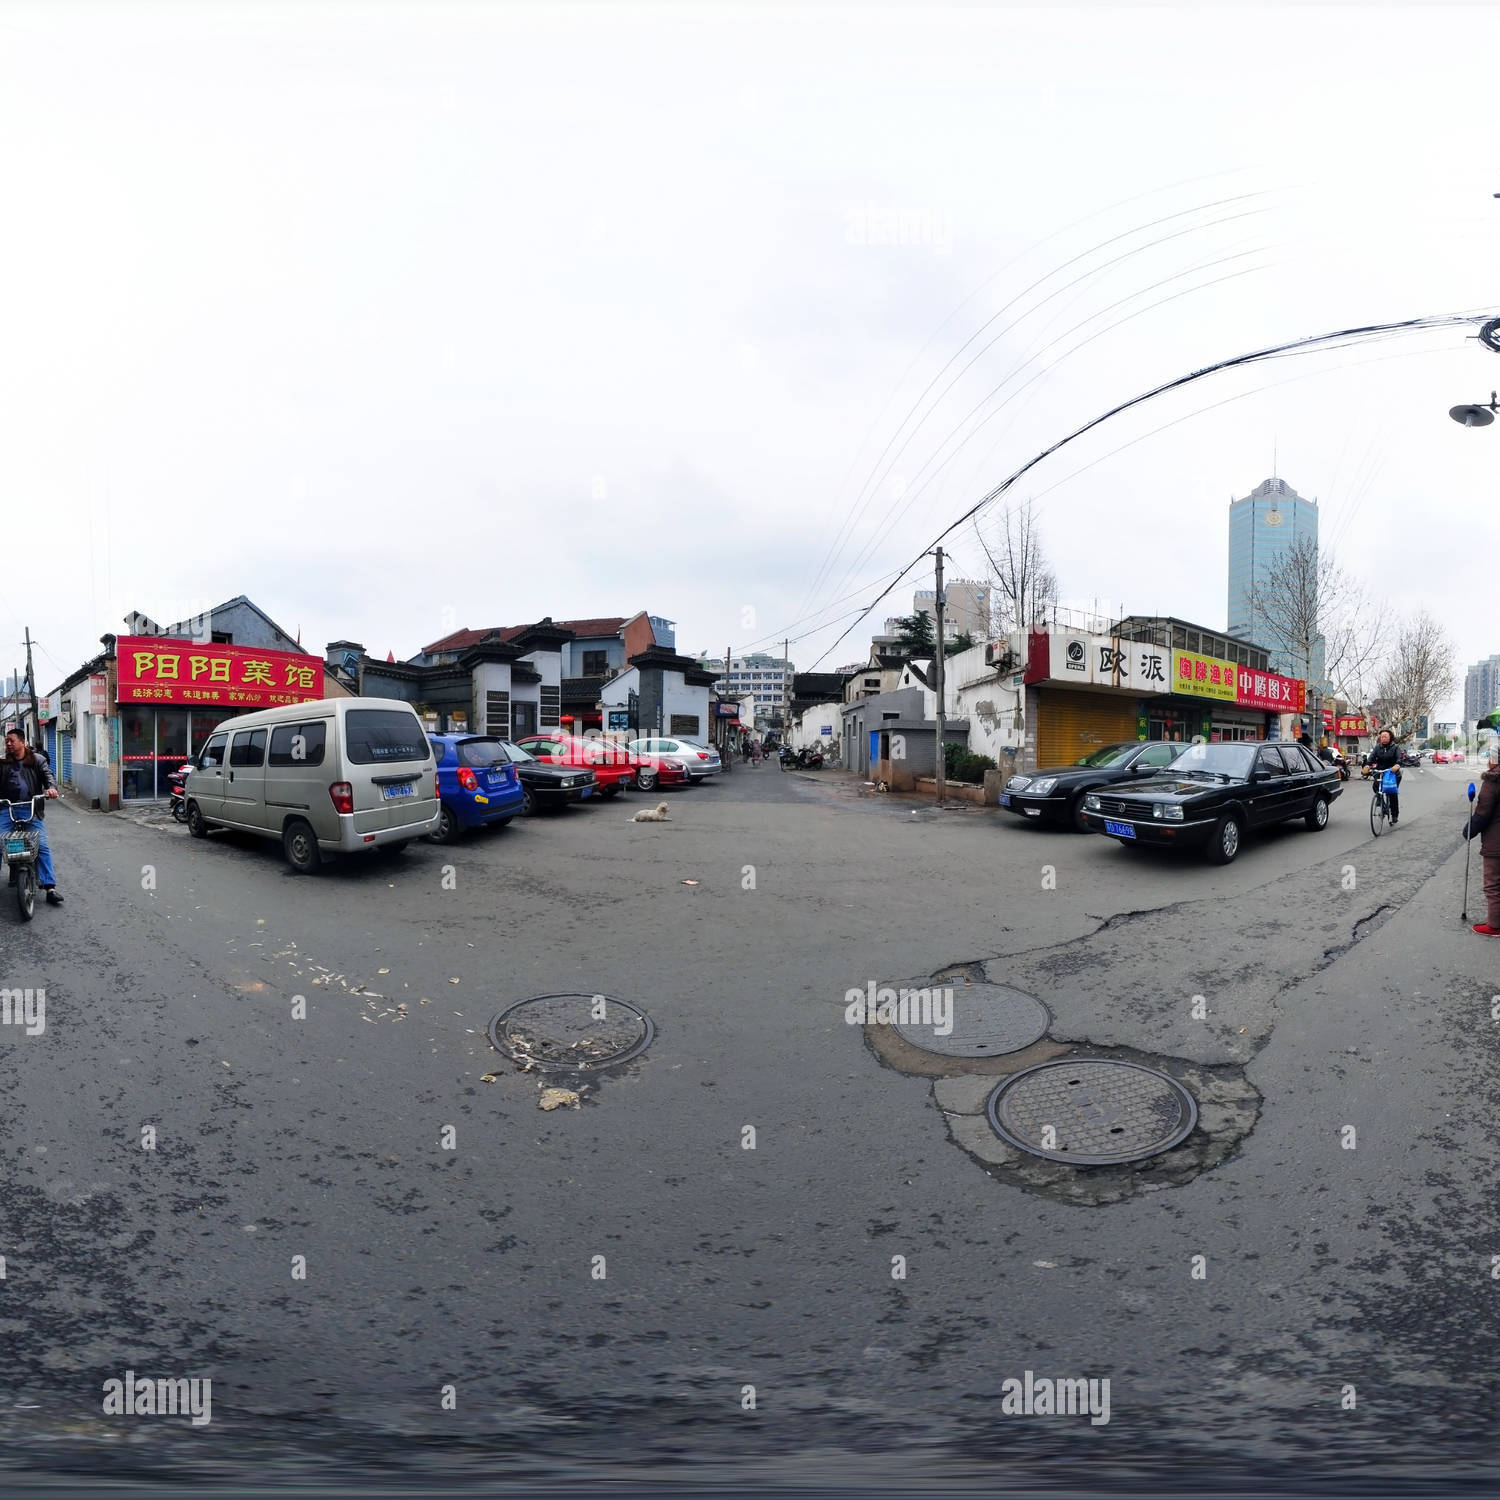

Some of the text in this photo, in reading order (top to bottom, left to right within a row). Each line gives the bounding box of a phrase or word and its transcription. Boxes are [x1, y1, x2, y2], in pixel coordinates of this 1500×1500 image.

[132, 652, 316, 689] 阳阳菜馆
[1100, 647, 1165, 682] 欧派
[1239, 664, 1291, 702] 中腾图文
